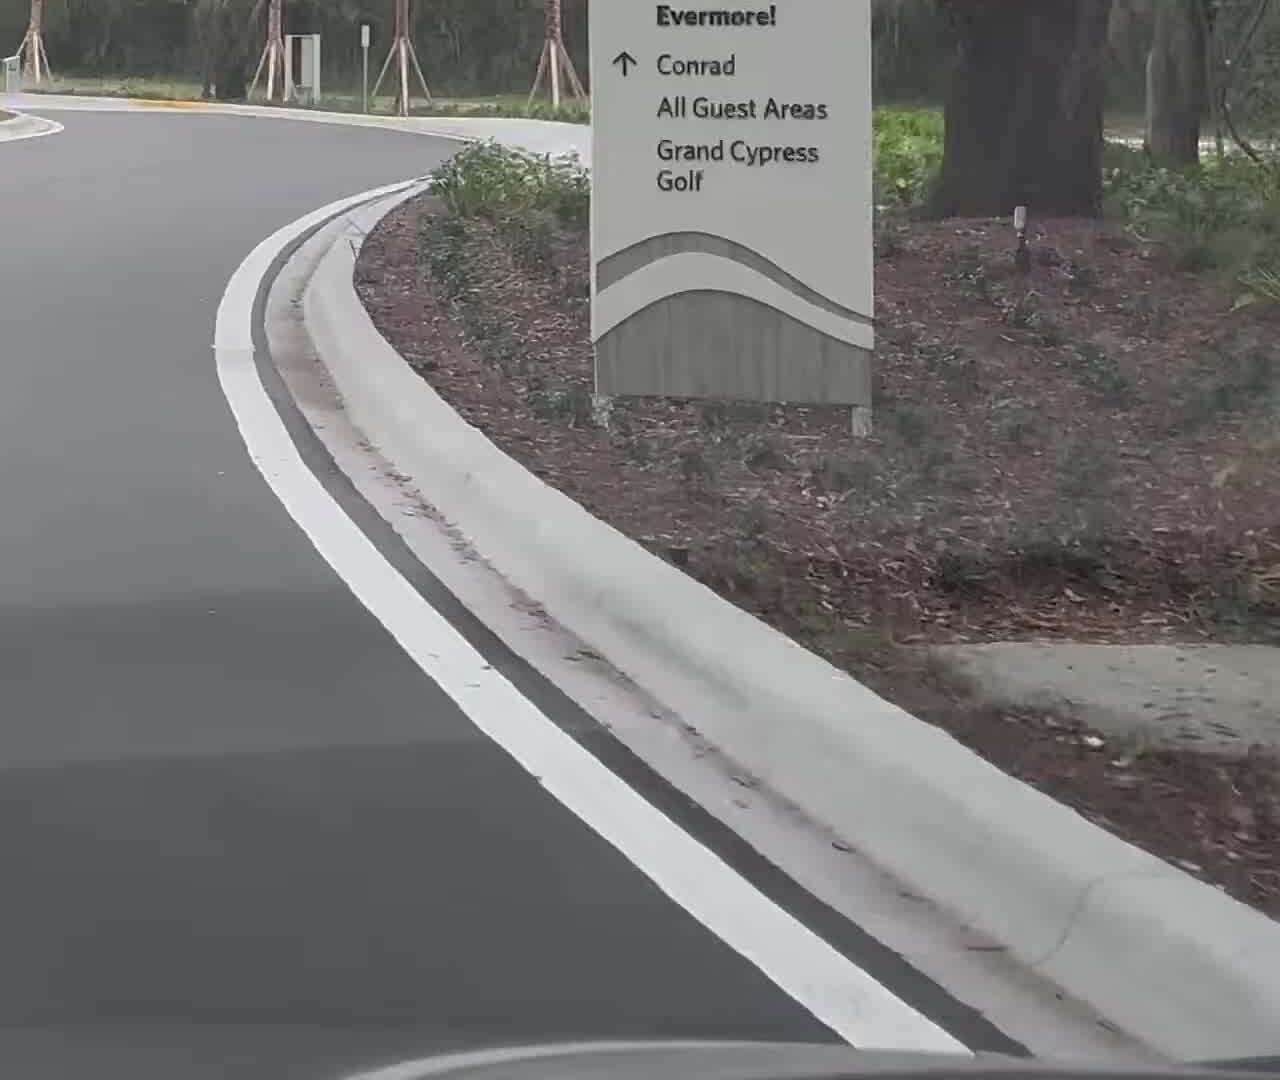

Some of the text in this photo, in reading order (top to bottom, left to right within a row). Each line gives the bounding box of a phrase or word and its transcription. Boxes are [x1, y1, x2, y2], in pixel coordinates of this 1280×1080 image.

[656, 5, 777, 26] Evermore!
[657, 54, 736, 76] Conrad
[657, 96, 828, 120] All Guest Areas
[657, 140, 820, 166] Grand Cypress
[657, 170, 704, 192] Golf
